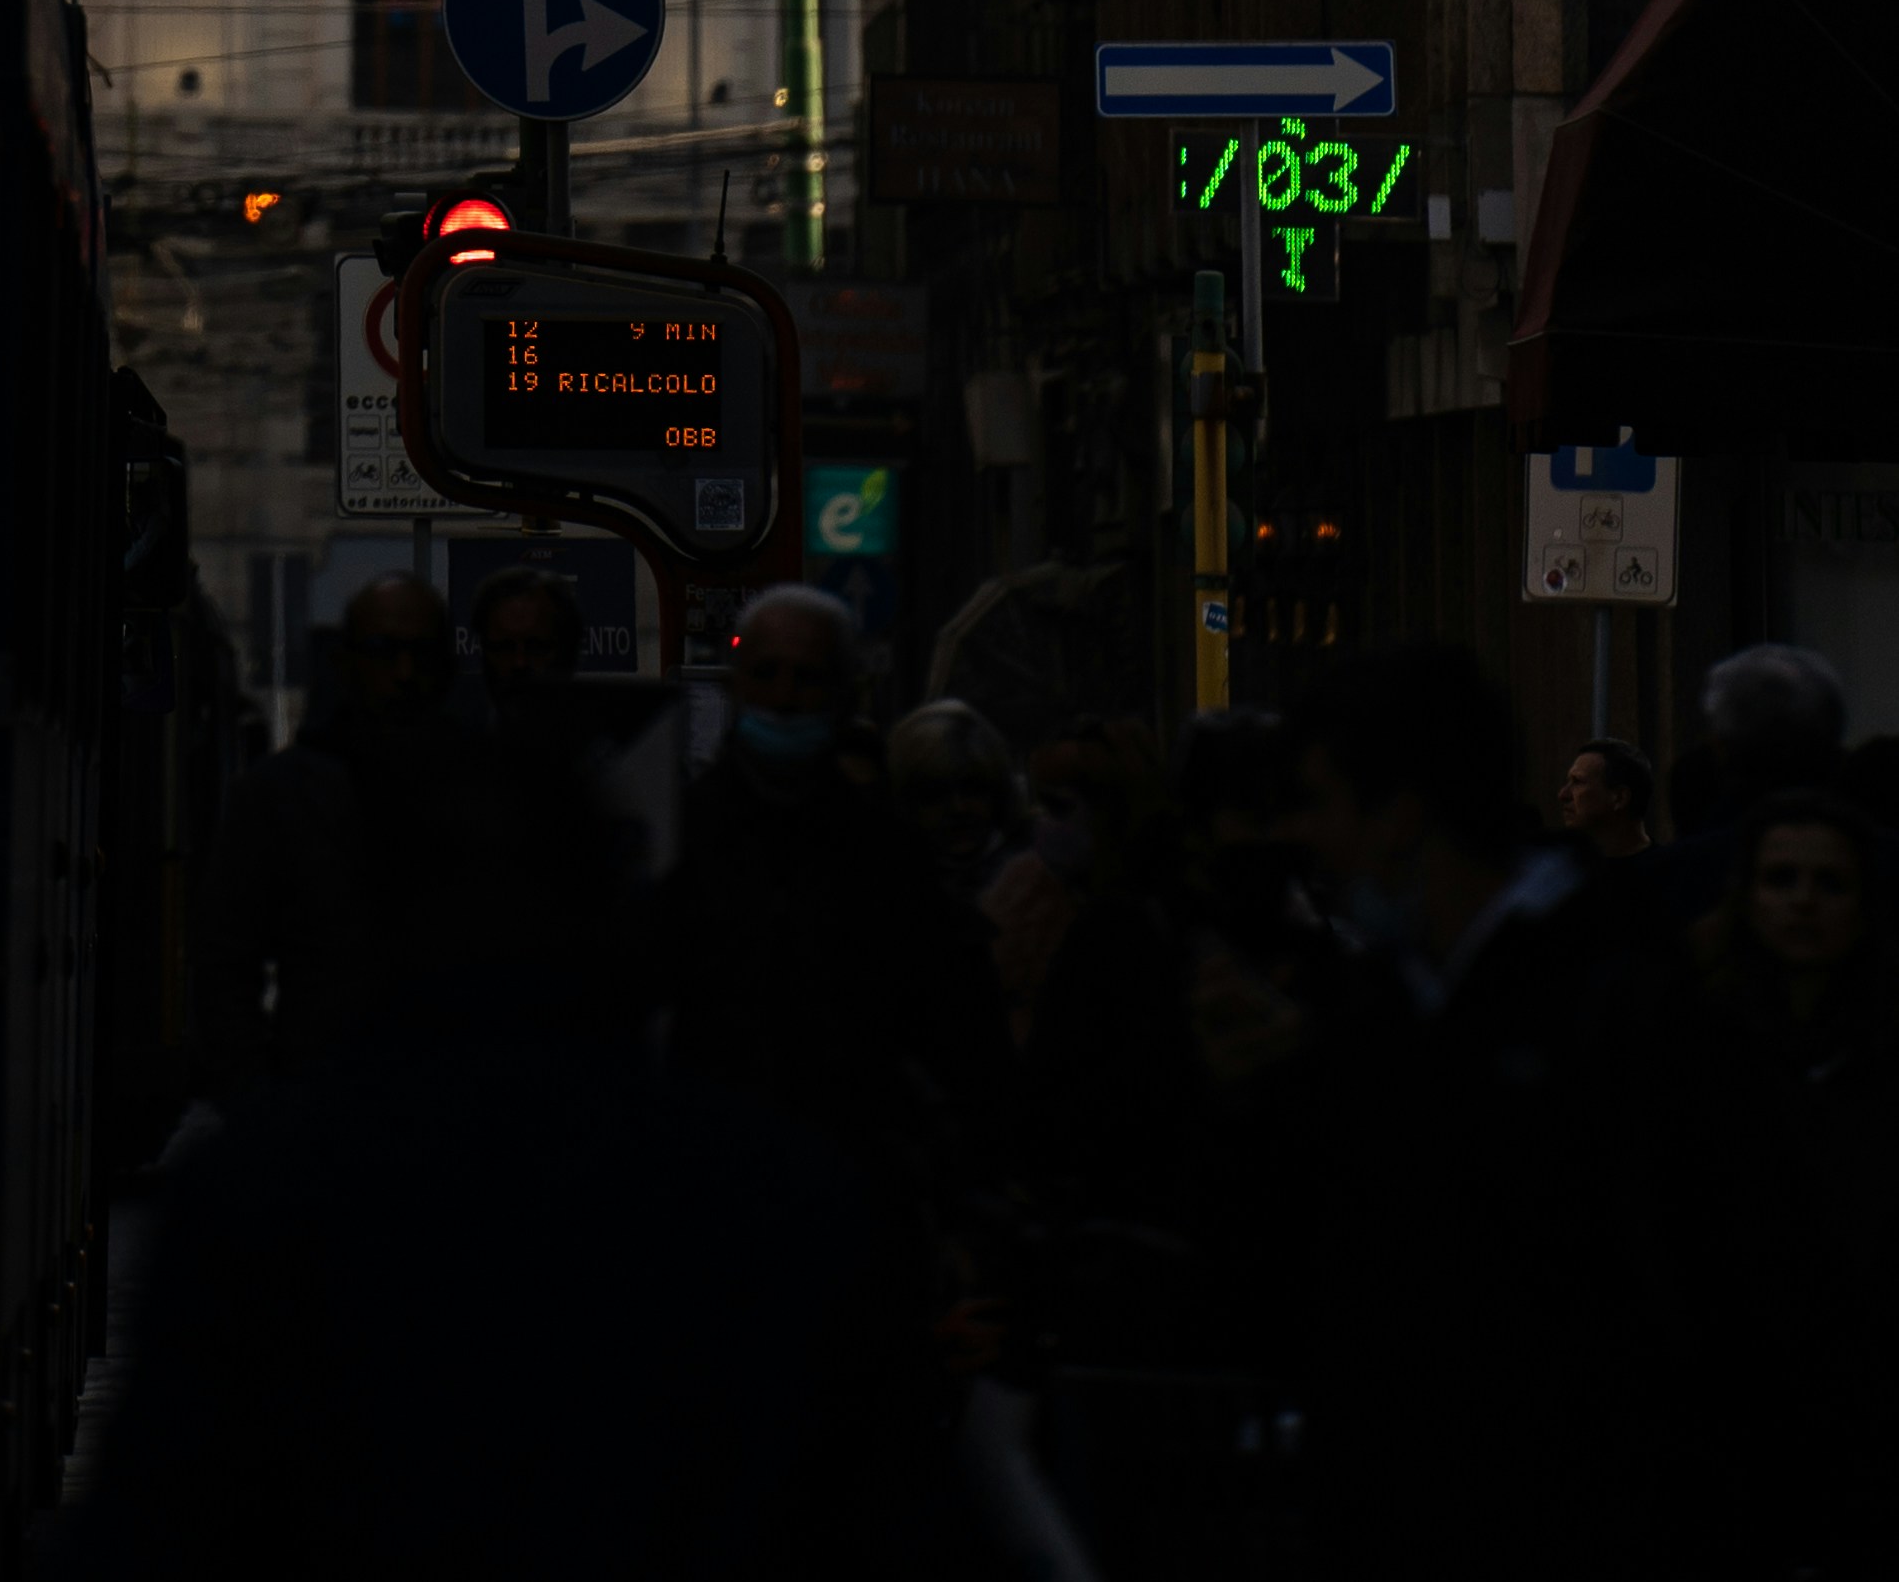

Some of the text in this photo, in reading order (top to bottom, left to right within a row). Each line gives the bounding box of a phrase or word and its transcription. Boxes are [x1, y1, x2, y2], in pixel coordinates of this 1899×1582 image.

[507, 321, 540, 339] 12
[665, 323, 717, 341] MIN
[507, 344, 540, 366] 16
[507, 371, 717, 395] 19 RICALCOLO
